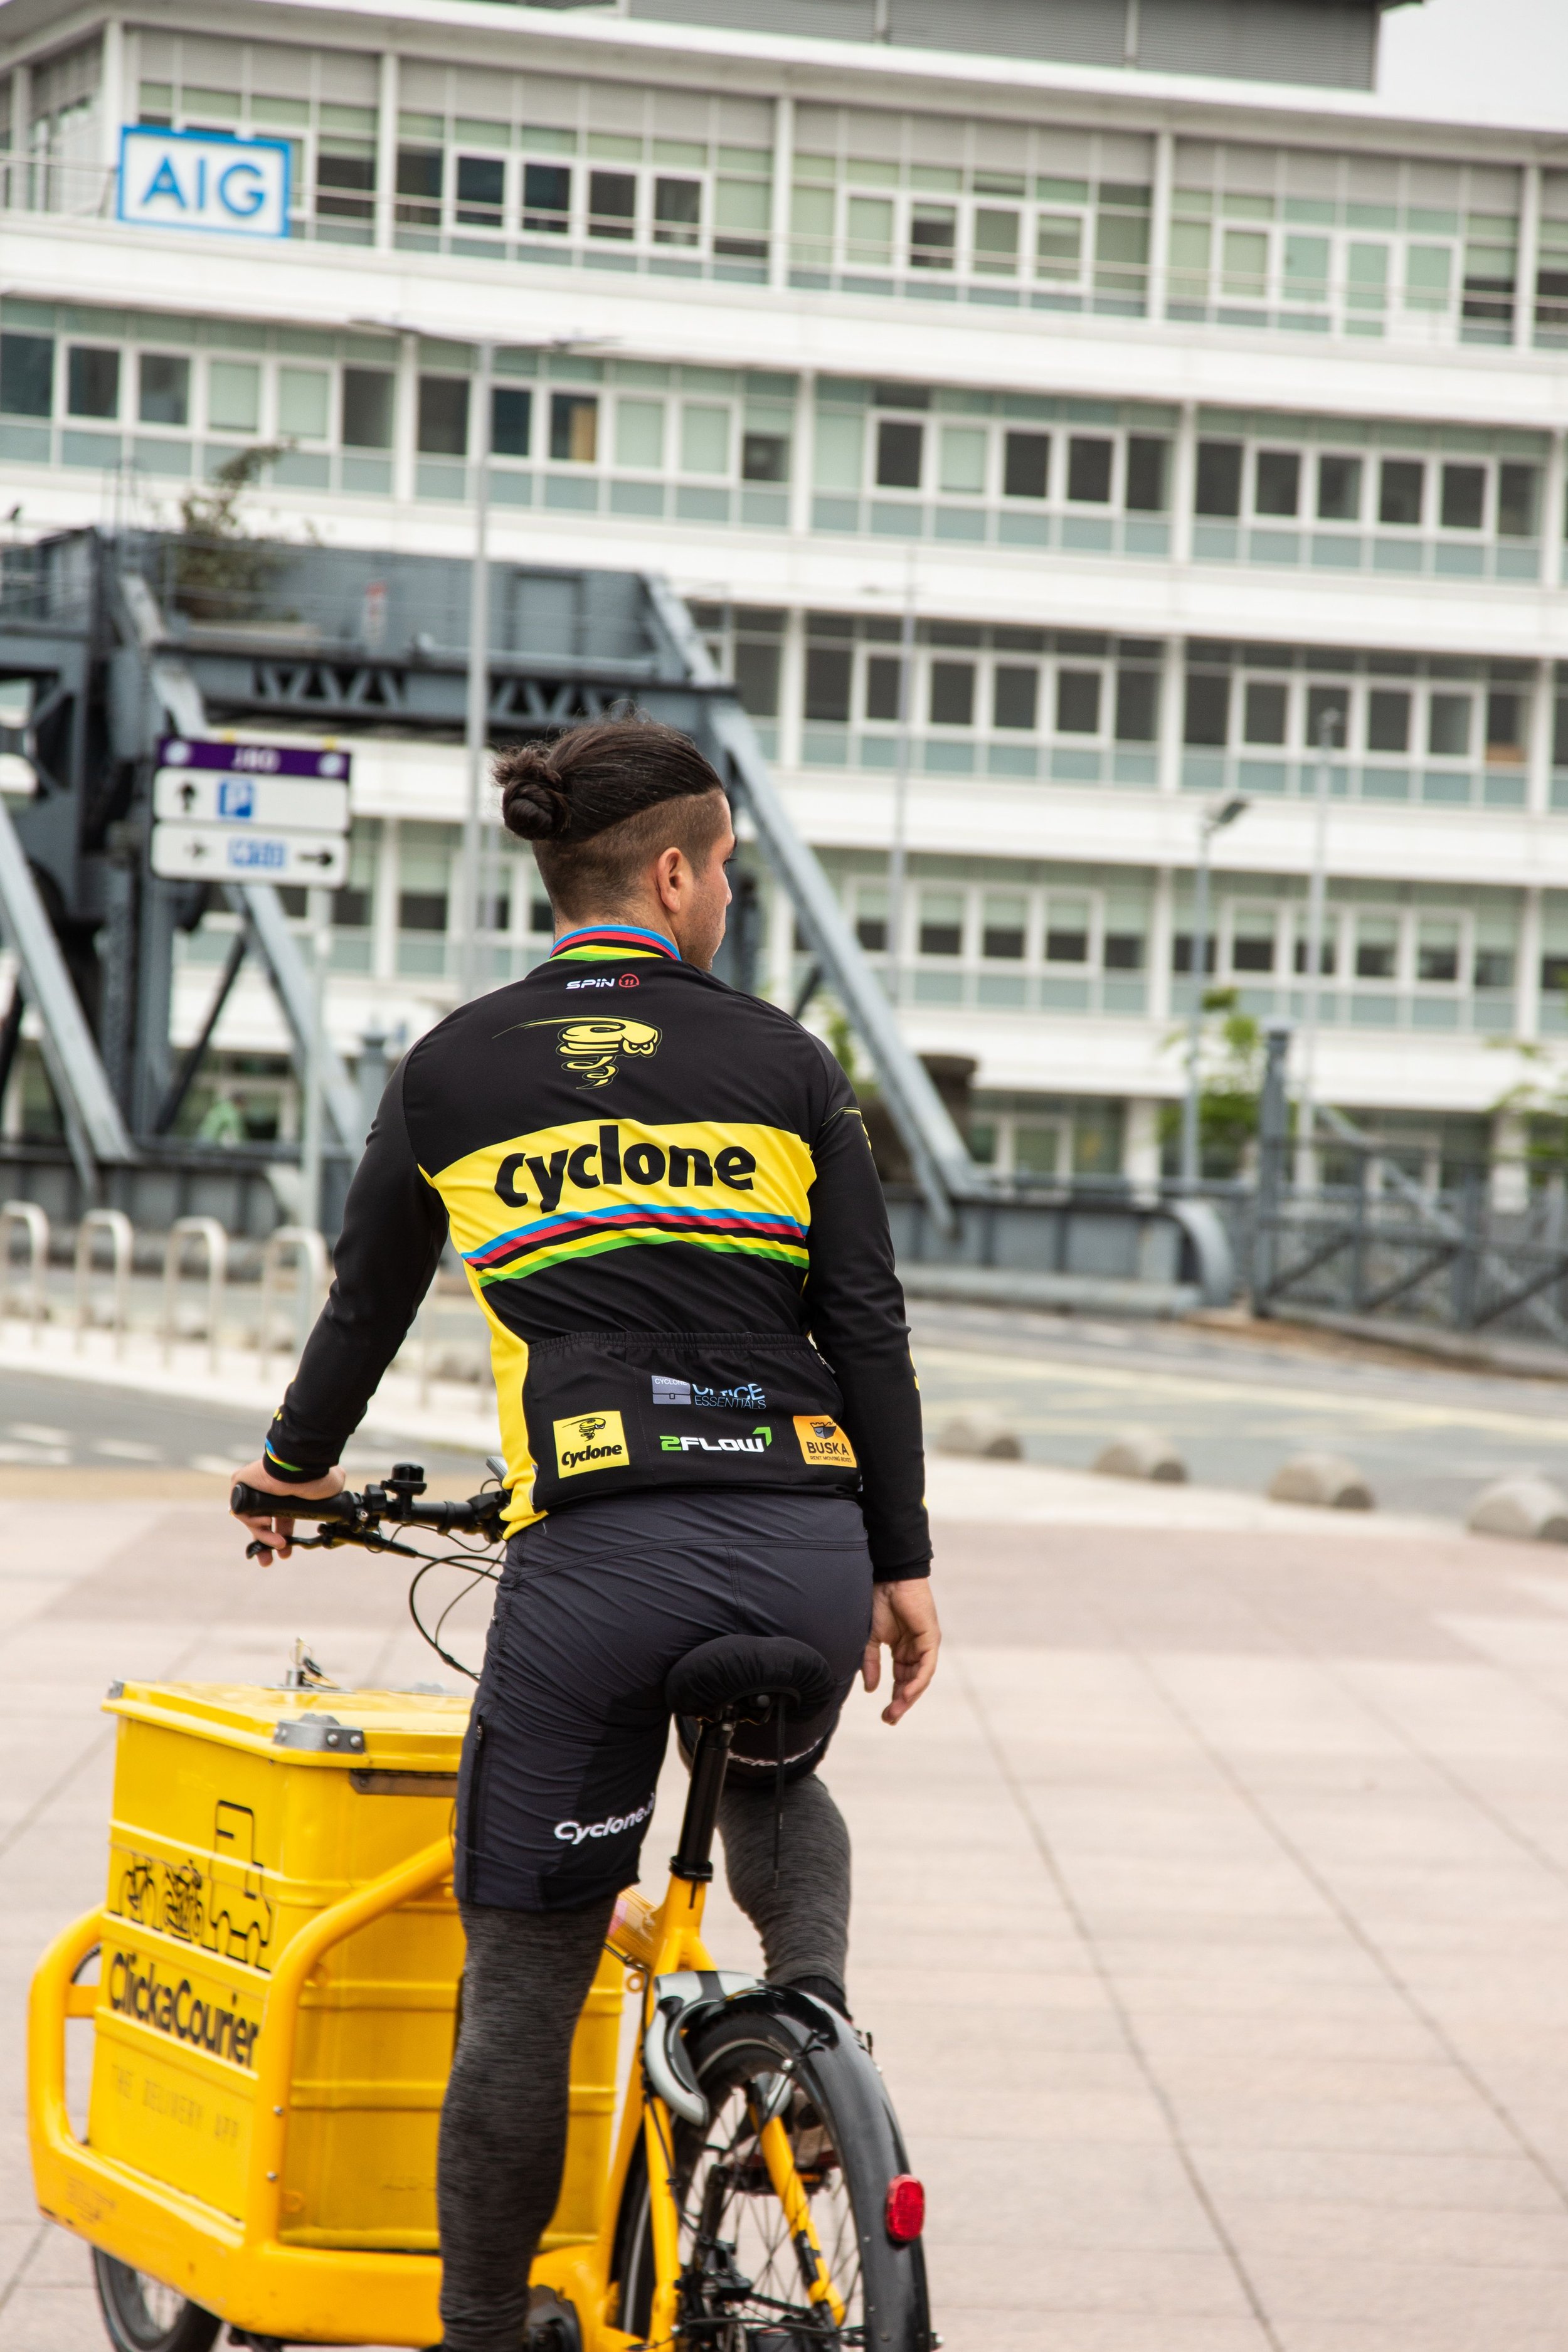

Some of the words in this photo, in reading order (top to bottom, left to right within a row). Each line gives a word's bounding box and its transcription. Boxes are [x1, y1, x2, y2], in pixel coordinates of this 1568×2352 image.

[141, 157, 265, 216] AIG
[692, 1384, 765, 1401] OICE
[694, 1396, 766, 1409] ESSENTIALS
[807, 1441, 849, 1455] BUSKA
[110, 1952, 259, 2069] ClickaCourier
